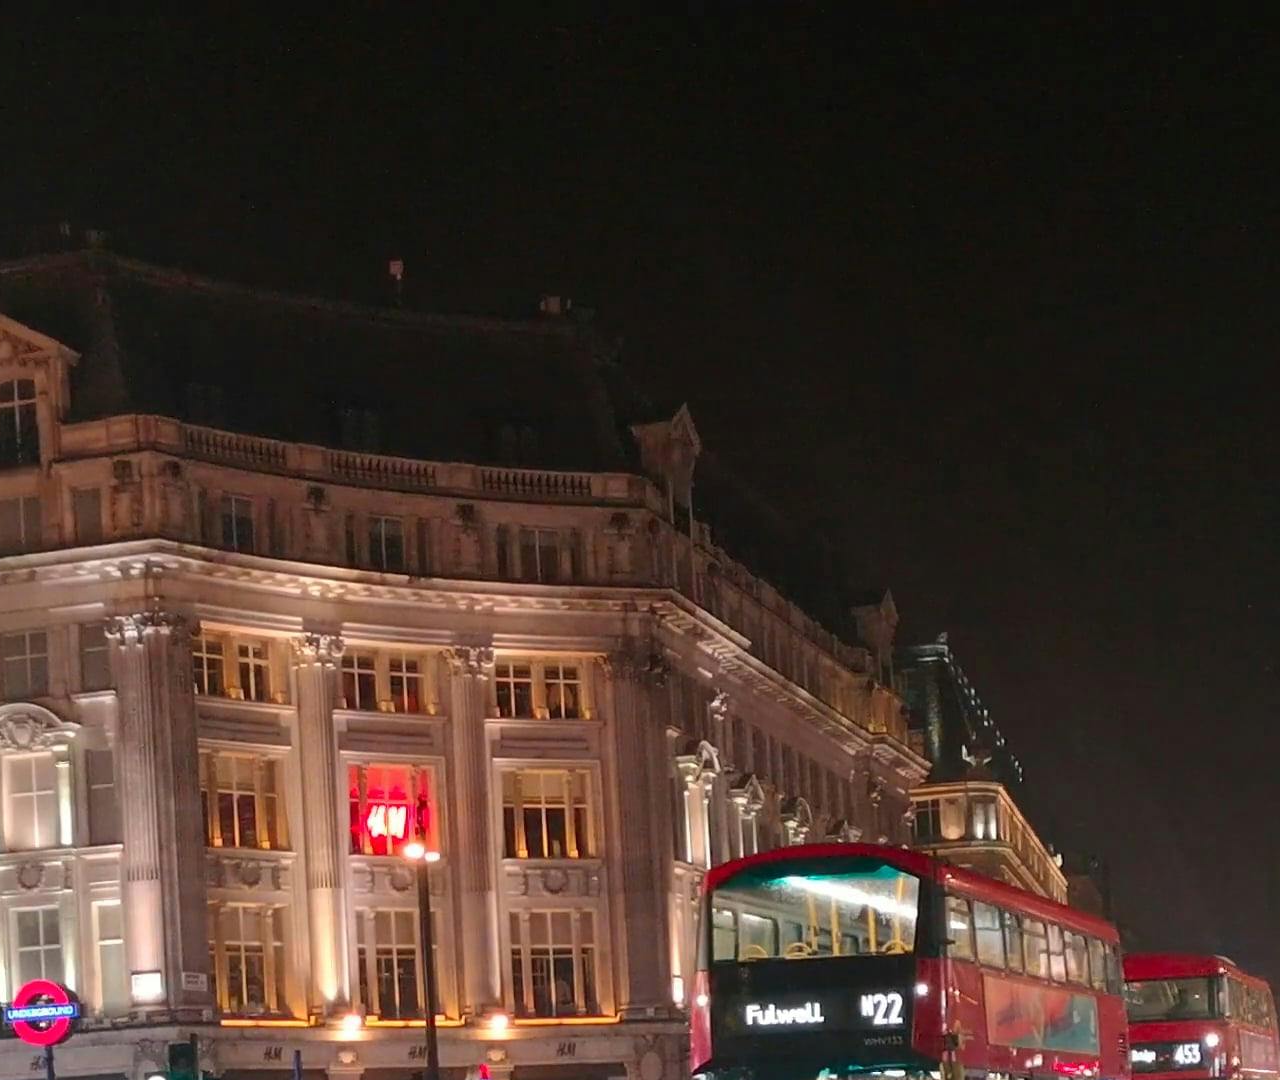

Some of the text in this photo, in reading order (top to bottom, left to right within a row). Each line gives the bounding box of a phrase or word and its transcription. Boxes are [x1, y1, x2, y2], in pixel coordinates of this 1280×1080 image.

[7, 1005, 74, 1020] UNDERGROUND
[745, 993, 903, 1025] Fulwell N22
[1175, 1043, 1201, 1064] 453
